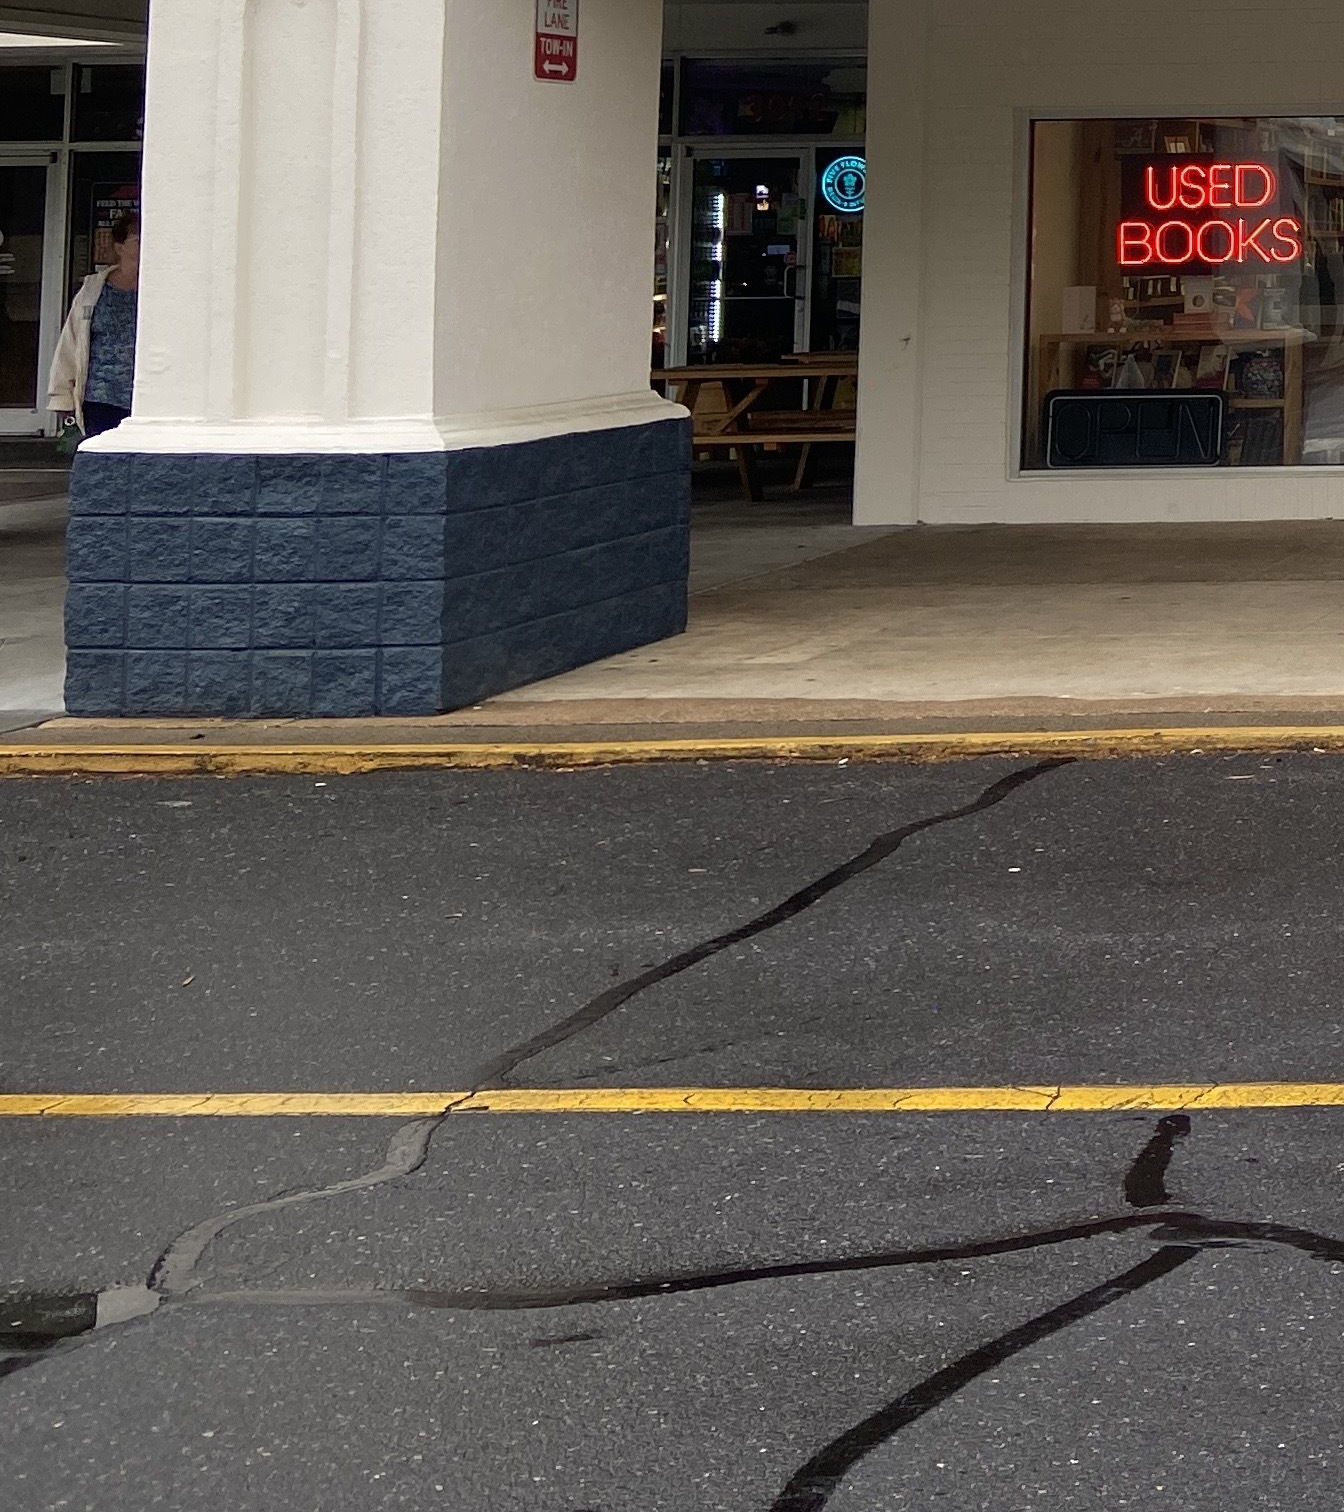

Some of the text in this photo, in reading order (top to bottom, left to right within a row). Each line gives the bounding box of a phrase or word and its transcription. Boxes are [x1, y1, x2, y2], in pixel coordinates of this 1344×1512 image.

[544, 12, 569, 29] LANE
[540, 37, 573, 57] TOW-IN
[1146, 164, 1274, 210] USED
[1119, 218, 1301, 265] BOOKS
[1056, 402, 1214, 461] OPEN
